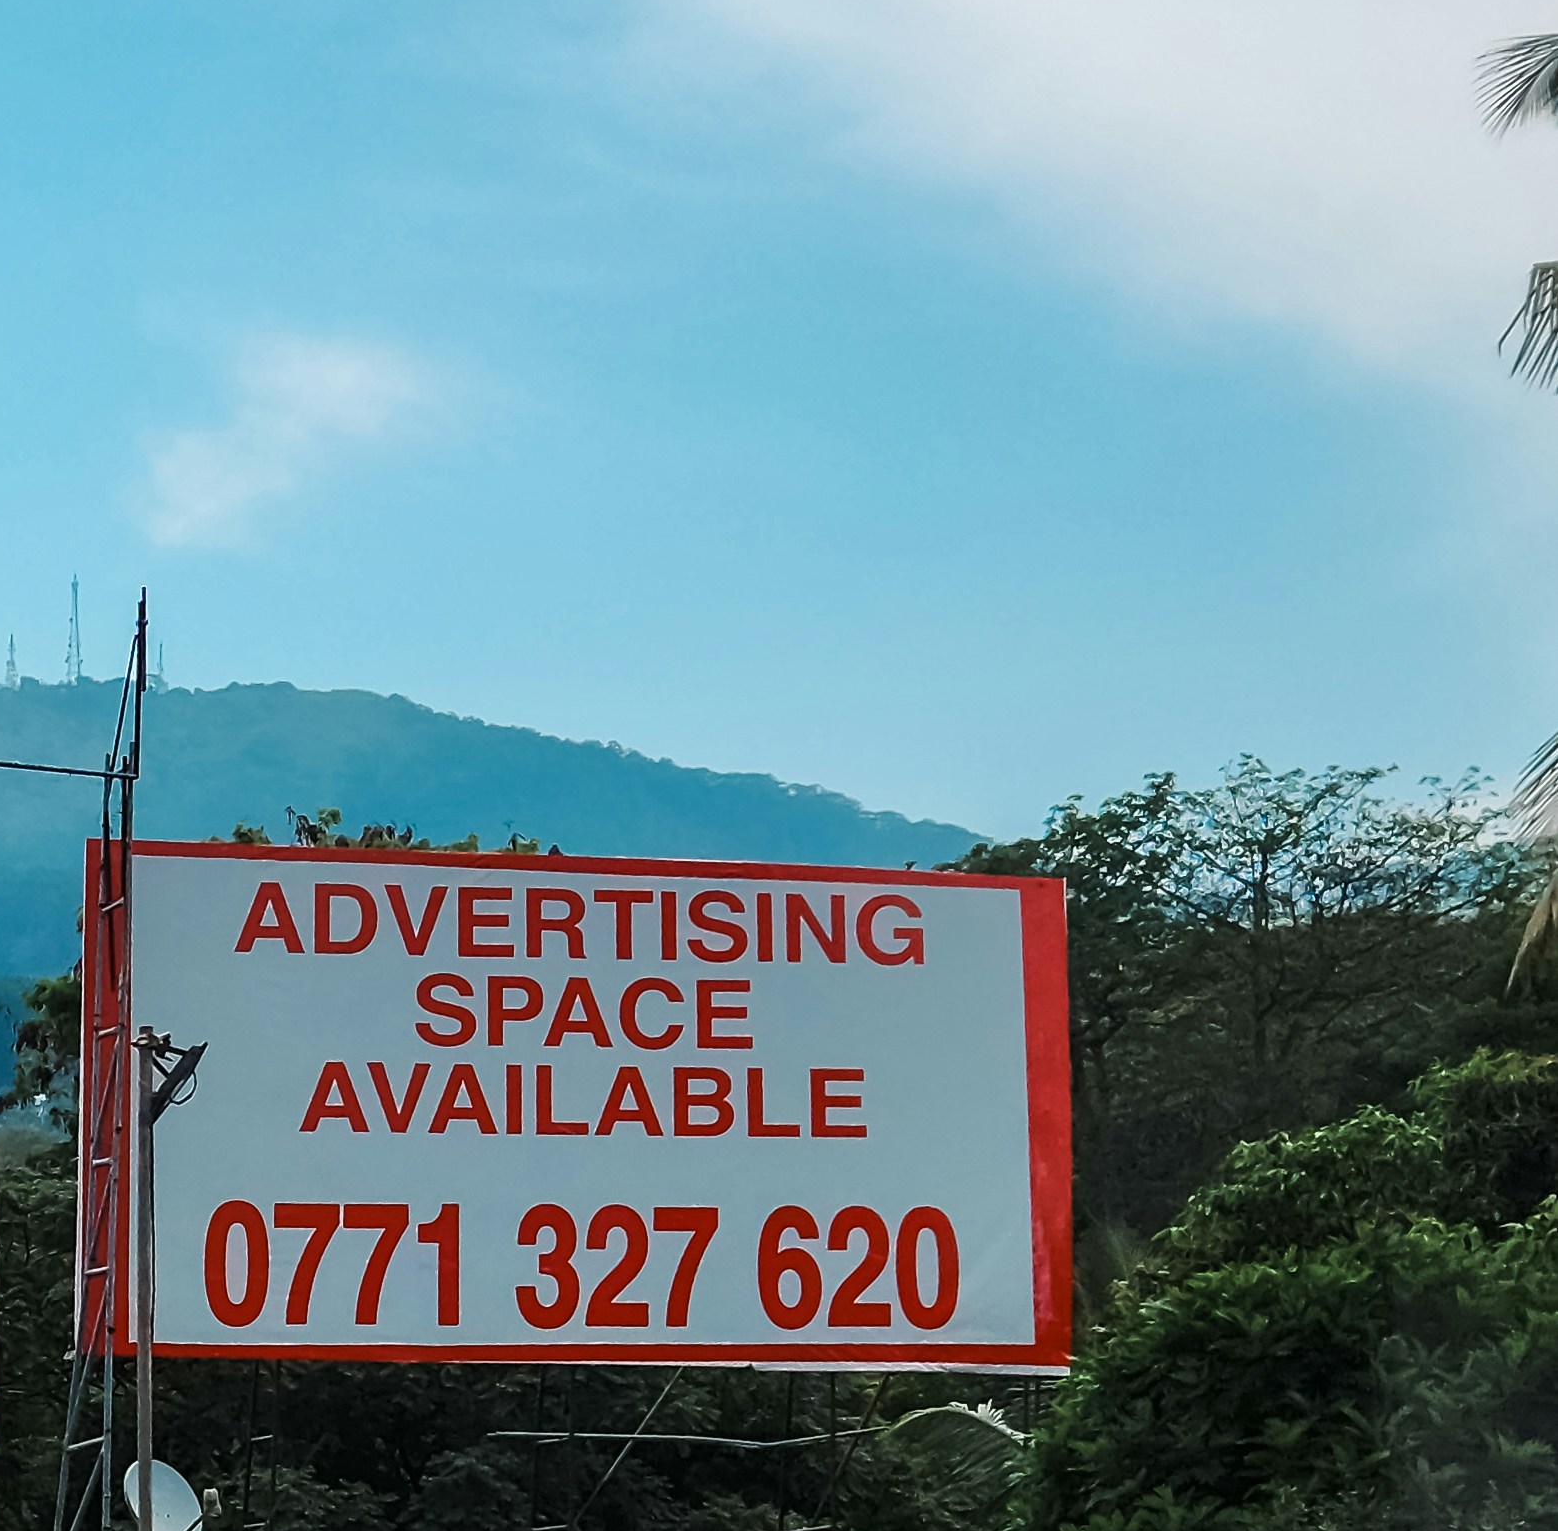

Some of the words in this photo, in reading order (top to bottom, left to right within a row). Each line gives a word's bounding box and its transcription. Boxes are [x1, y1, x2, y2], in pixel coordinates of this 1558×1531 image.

[236, 883, 924, 965] ADVERTISING
[416, 974, 753, 1050] SPACE
[301, 1062, 867, 1137] AVAILABLE
[204, 1200, 460, 1327] 0771
[516, 1204, 719, 1329] 327
[758, 1205, 959, 1330] 620
